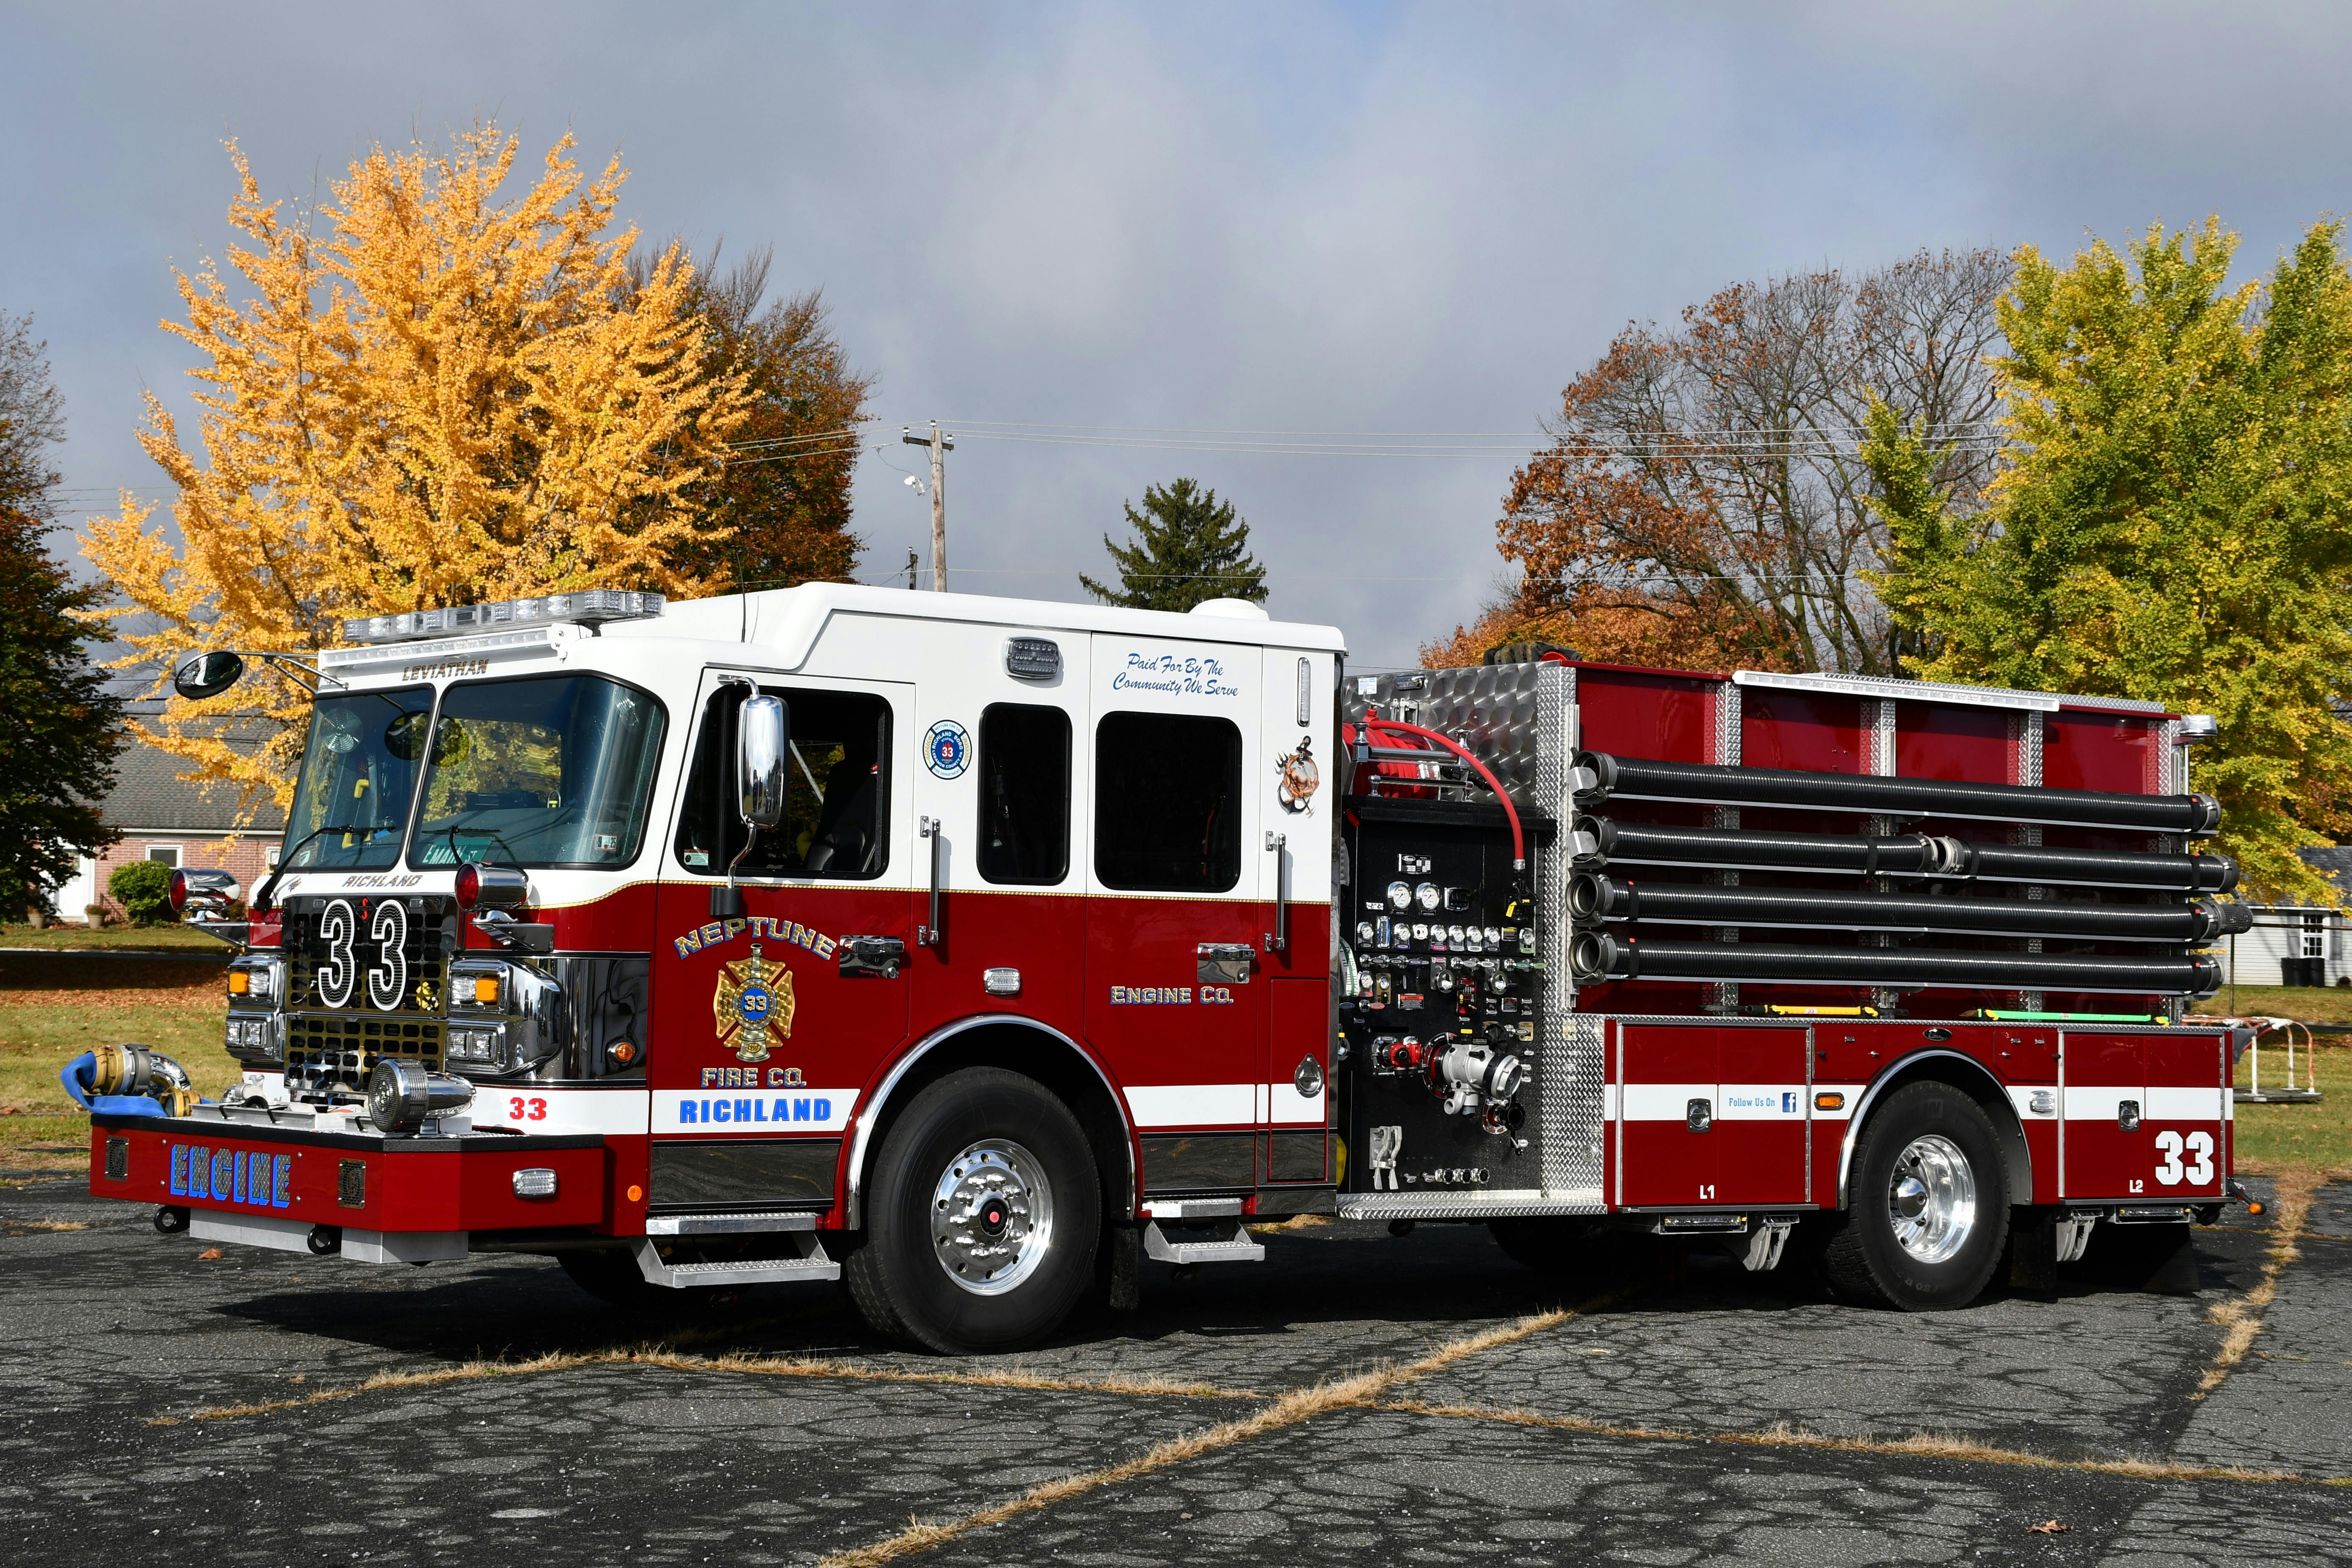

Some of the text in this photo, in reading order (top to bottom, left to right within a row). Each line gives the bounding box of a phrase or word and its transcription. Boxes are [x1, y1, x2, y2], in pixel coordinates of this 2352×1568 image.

[402, 659, 489, 681] LEVIATHAN
[1127, 653, 1224, 678] Paid For By The
[1113, 672, 1239, 696] Community We Serve
[932, 732, 963, 750] RICHLAND BORO
[932, 750, 945, 768] LEBANON
[946, 758, 960, 768] COUNTY
[942, 747, 953, 757] 33
[610, 838, 616, 848] 25
[428, 846, 467, 864] MAIN
[342, 874, 423, 888] RICHLAND
[673, 917, 838, 961] NEPTUNE
[318, 899, 408, 1011] 33
[743, 995, 767, 1012] 33
[1110, 986, 1191, 1005] ENGINE
[700, 1067, 807, 1088] FIRE CO.
[509, 1097, 547, 1121] 33
[680, 1098, 831, 1123] RICHLAND
[1729, 1098, 1775, 1106] Follow Us On
[2155, 1130, 2214, 1186] 33
[170, 1143, 291, 1209] ENGINE
[1699, 1185, 1714, 1200] L1
[2129, 1179, 2143, 1193] L2
